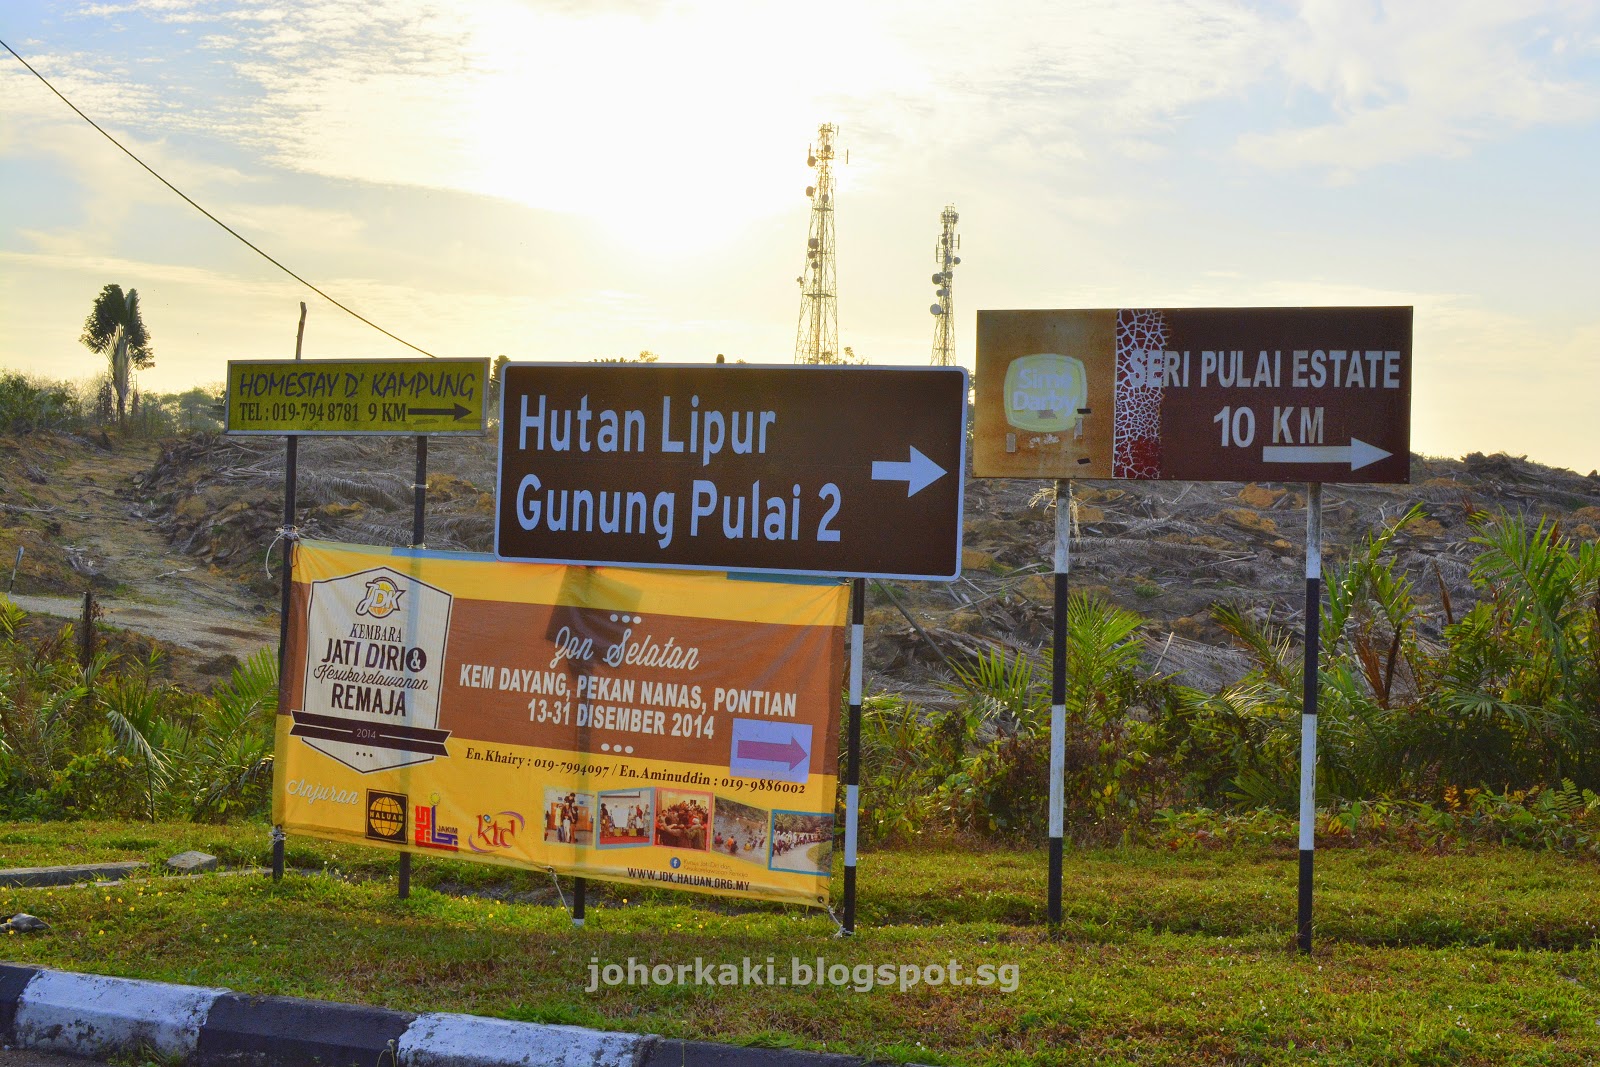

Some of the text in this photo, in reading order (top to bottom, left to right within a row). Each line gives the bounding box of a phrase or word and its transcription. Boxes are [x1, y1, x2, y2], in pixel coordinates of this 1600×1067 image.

[239, 371, 476, 401] HOMESTAY D' KAMPUNG
[1129, 349, 1401, 389] SERI PULAI ESTATE
[327, 403, 359, 421] 8781
[368, 404, 377, 421] 9
[382, 403, 407, 421] KM
[1213, 405, 1325, 449] 10 KM
[518, 393, 776, 467] Hutan Lipur
[515, 473, 842, 549] Gunung Pulai 2
[349, 623, 402, 643] KEMBARA
[549, 625, 699, 671] Zon Selatan
[321, 638, 361, 667] JATI
[365, 643, 406, 672] DIRI
[313, 664, 429, 691] Kesukarelawanan
[459, 663, 797, 717] KEM DAYANG, PEKAN NANAS, PONTIAN
[331, 683, 406, 717] REMAJA
[356, 728, 377, 739] 2014
[528, 698, 715, 740] 13-31 DISEMBER 2014
[286, 778, 360, 806] Anjuran
[534, 758, 610, 778] 019-7994097
[721, 777, 806, 794] 019-9886002
[370, 811, 404, 822] HALUAN
[437, 825, 458, 834] JAKIM
[627, 867, 750, 891] WWW.JDK.HALUAN.ORG.MY
